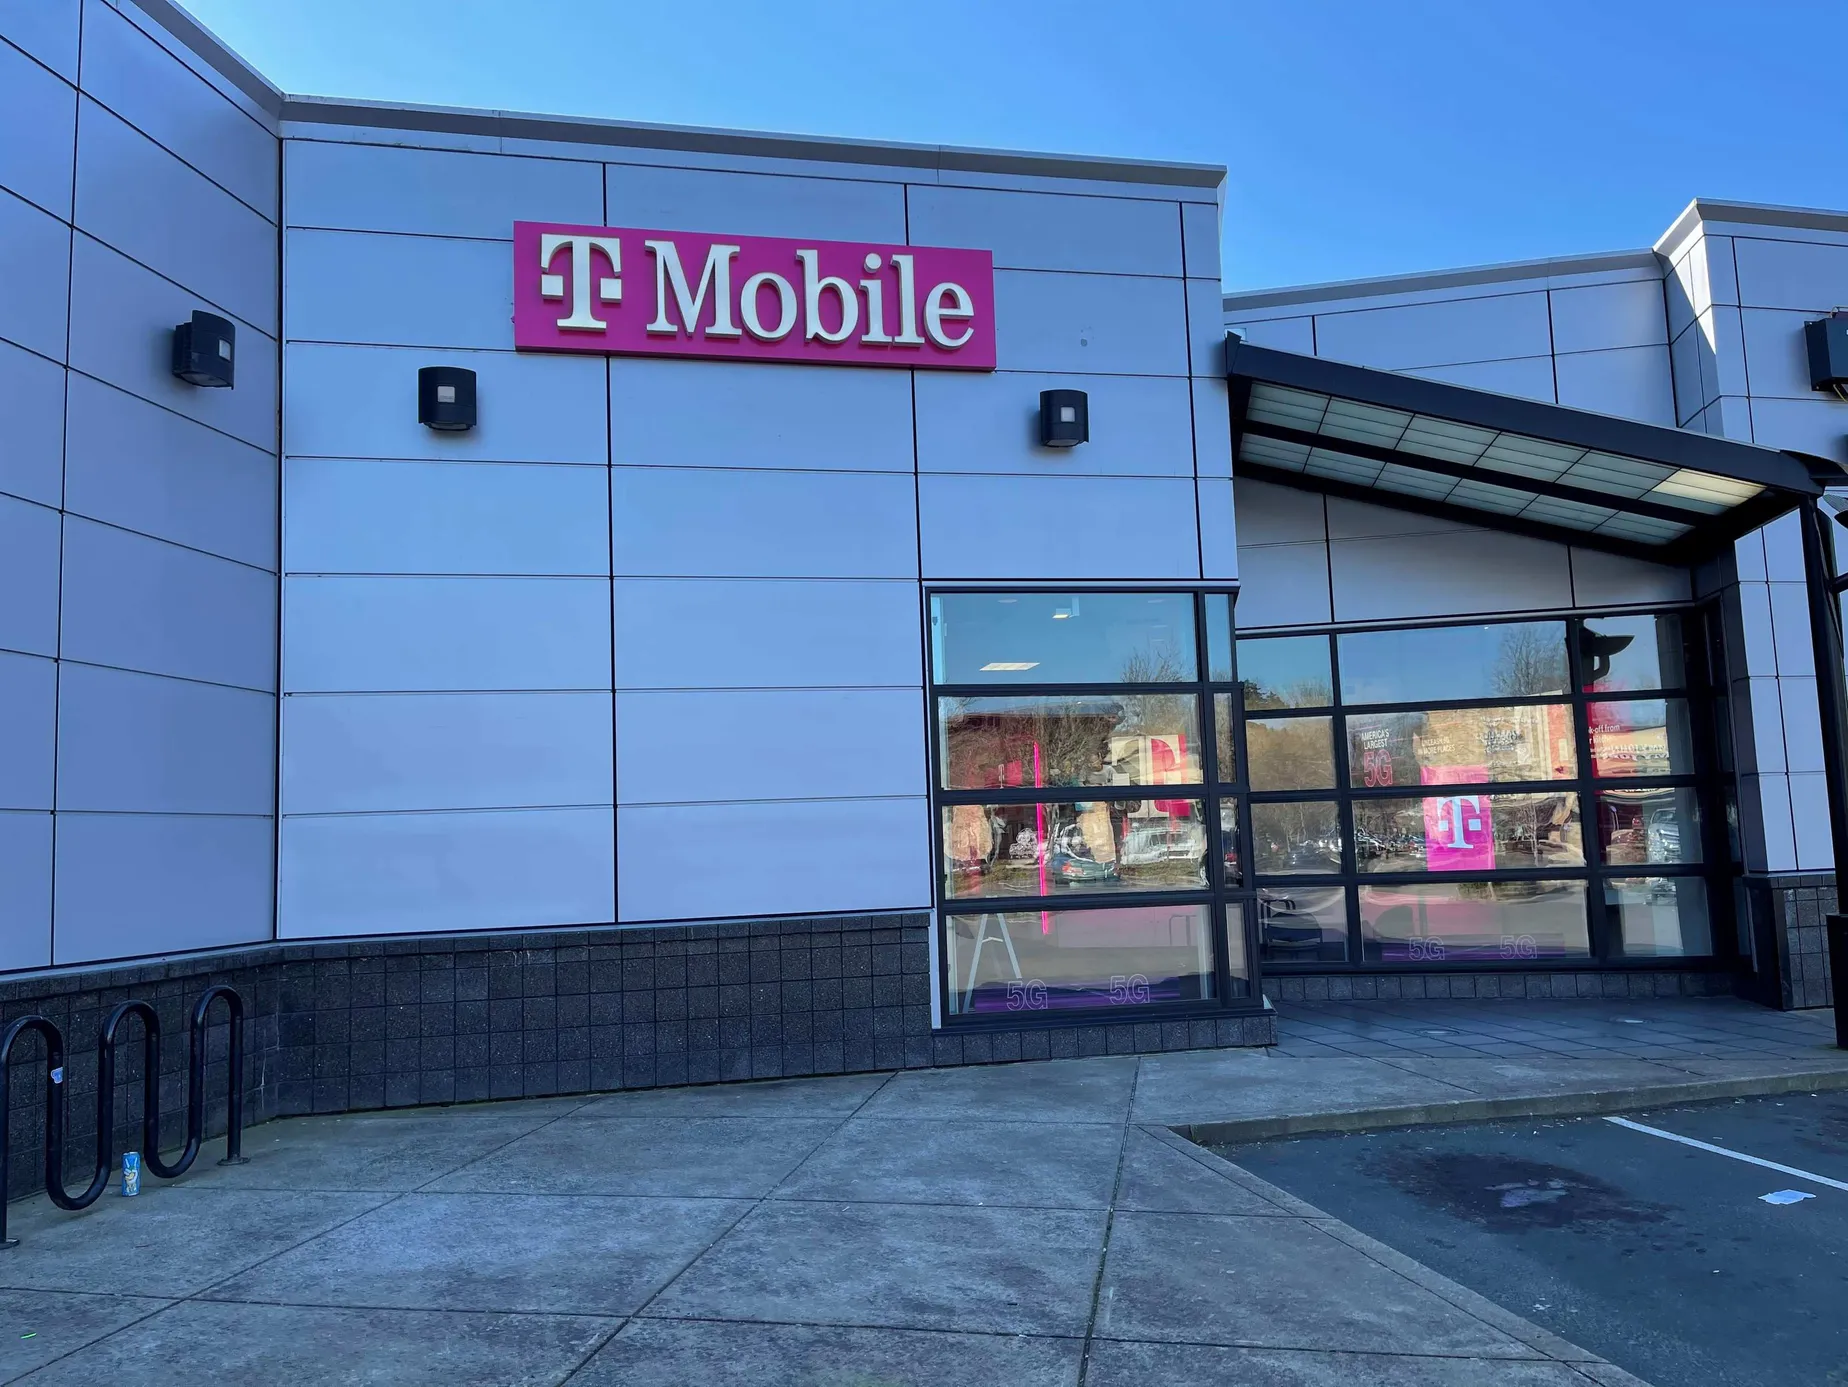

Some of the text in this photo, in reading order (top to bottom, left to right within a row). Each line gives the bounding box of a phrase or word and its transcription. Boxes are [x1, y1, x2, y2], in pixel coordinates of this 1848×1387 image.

[645, 239, 975, 351] Mobile
[1361, 728, 1390, 741] AMERICA'S
[1604, 724, 1620, 733] from
[1363, 738, 1388, 750] LARGEST
[1363, 749, 1393, 788] 5G
[1408, 934, 1538, 961] 5G 5G
[1006, 973, 1151, 1012] 5G 5G
